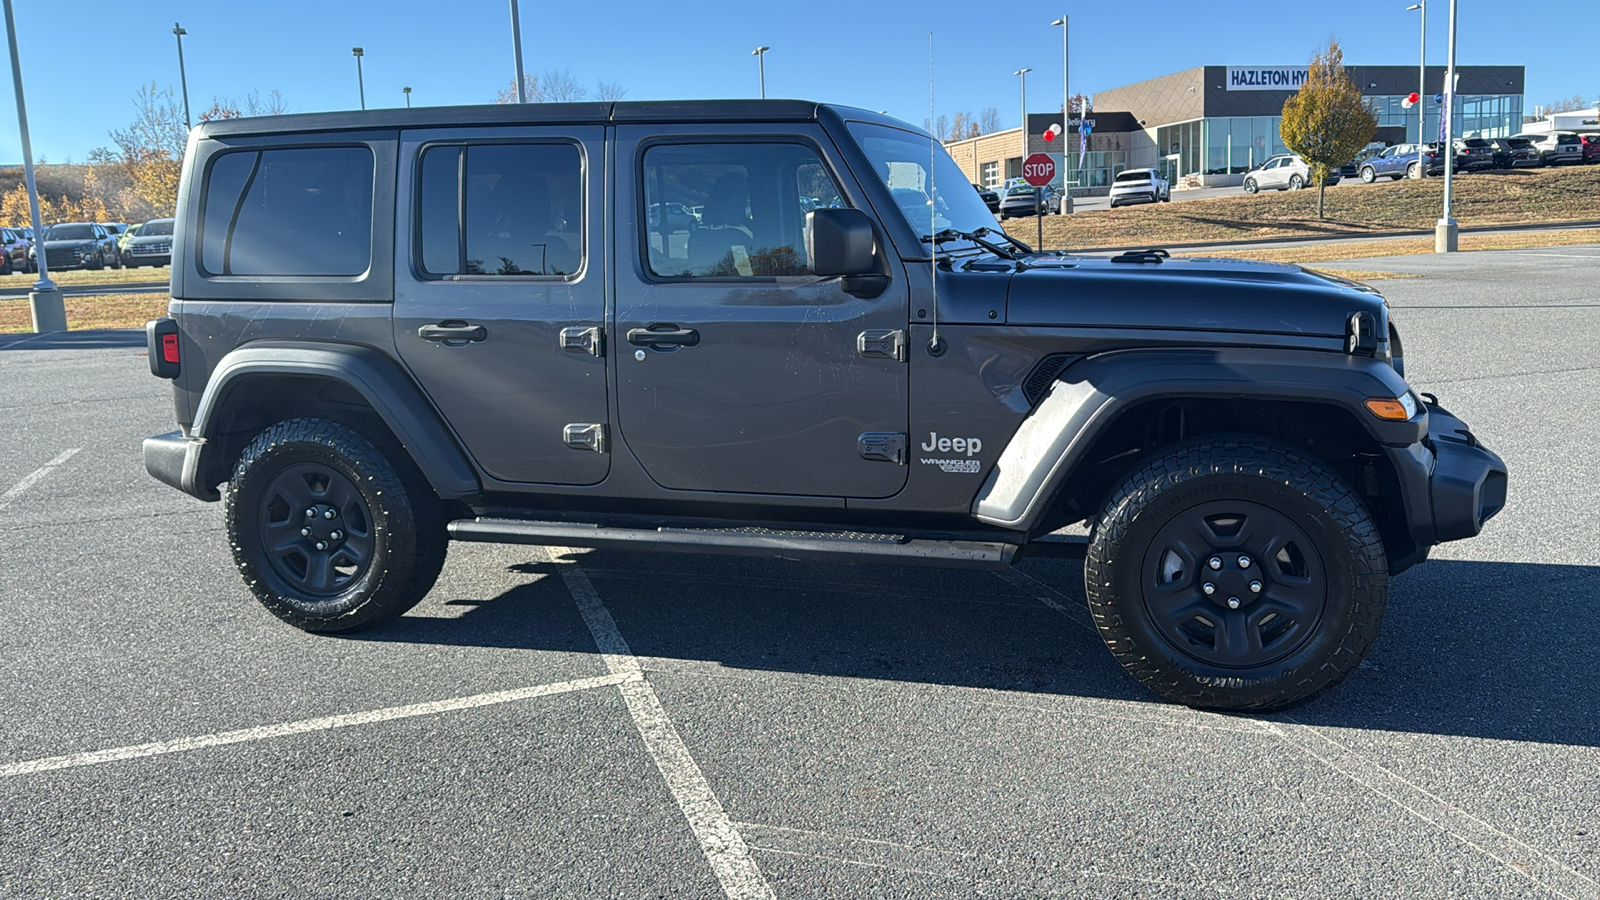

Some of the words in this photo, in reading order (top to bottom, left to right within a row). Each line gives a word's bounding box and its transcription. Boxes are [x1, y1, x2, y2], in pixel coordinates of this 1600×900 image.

[1231, 70, 1290, 86] HAZLETON
[1024, 163, 1054, 177] STOP
[921, 431, 982, 457] Jeep
[920, 458, 981, 466] WRANGLER
